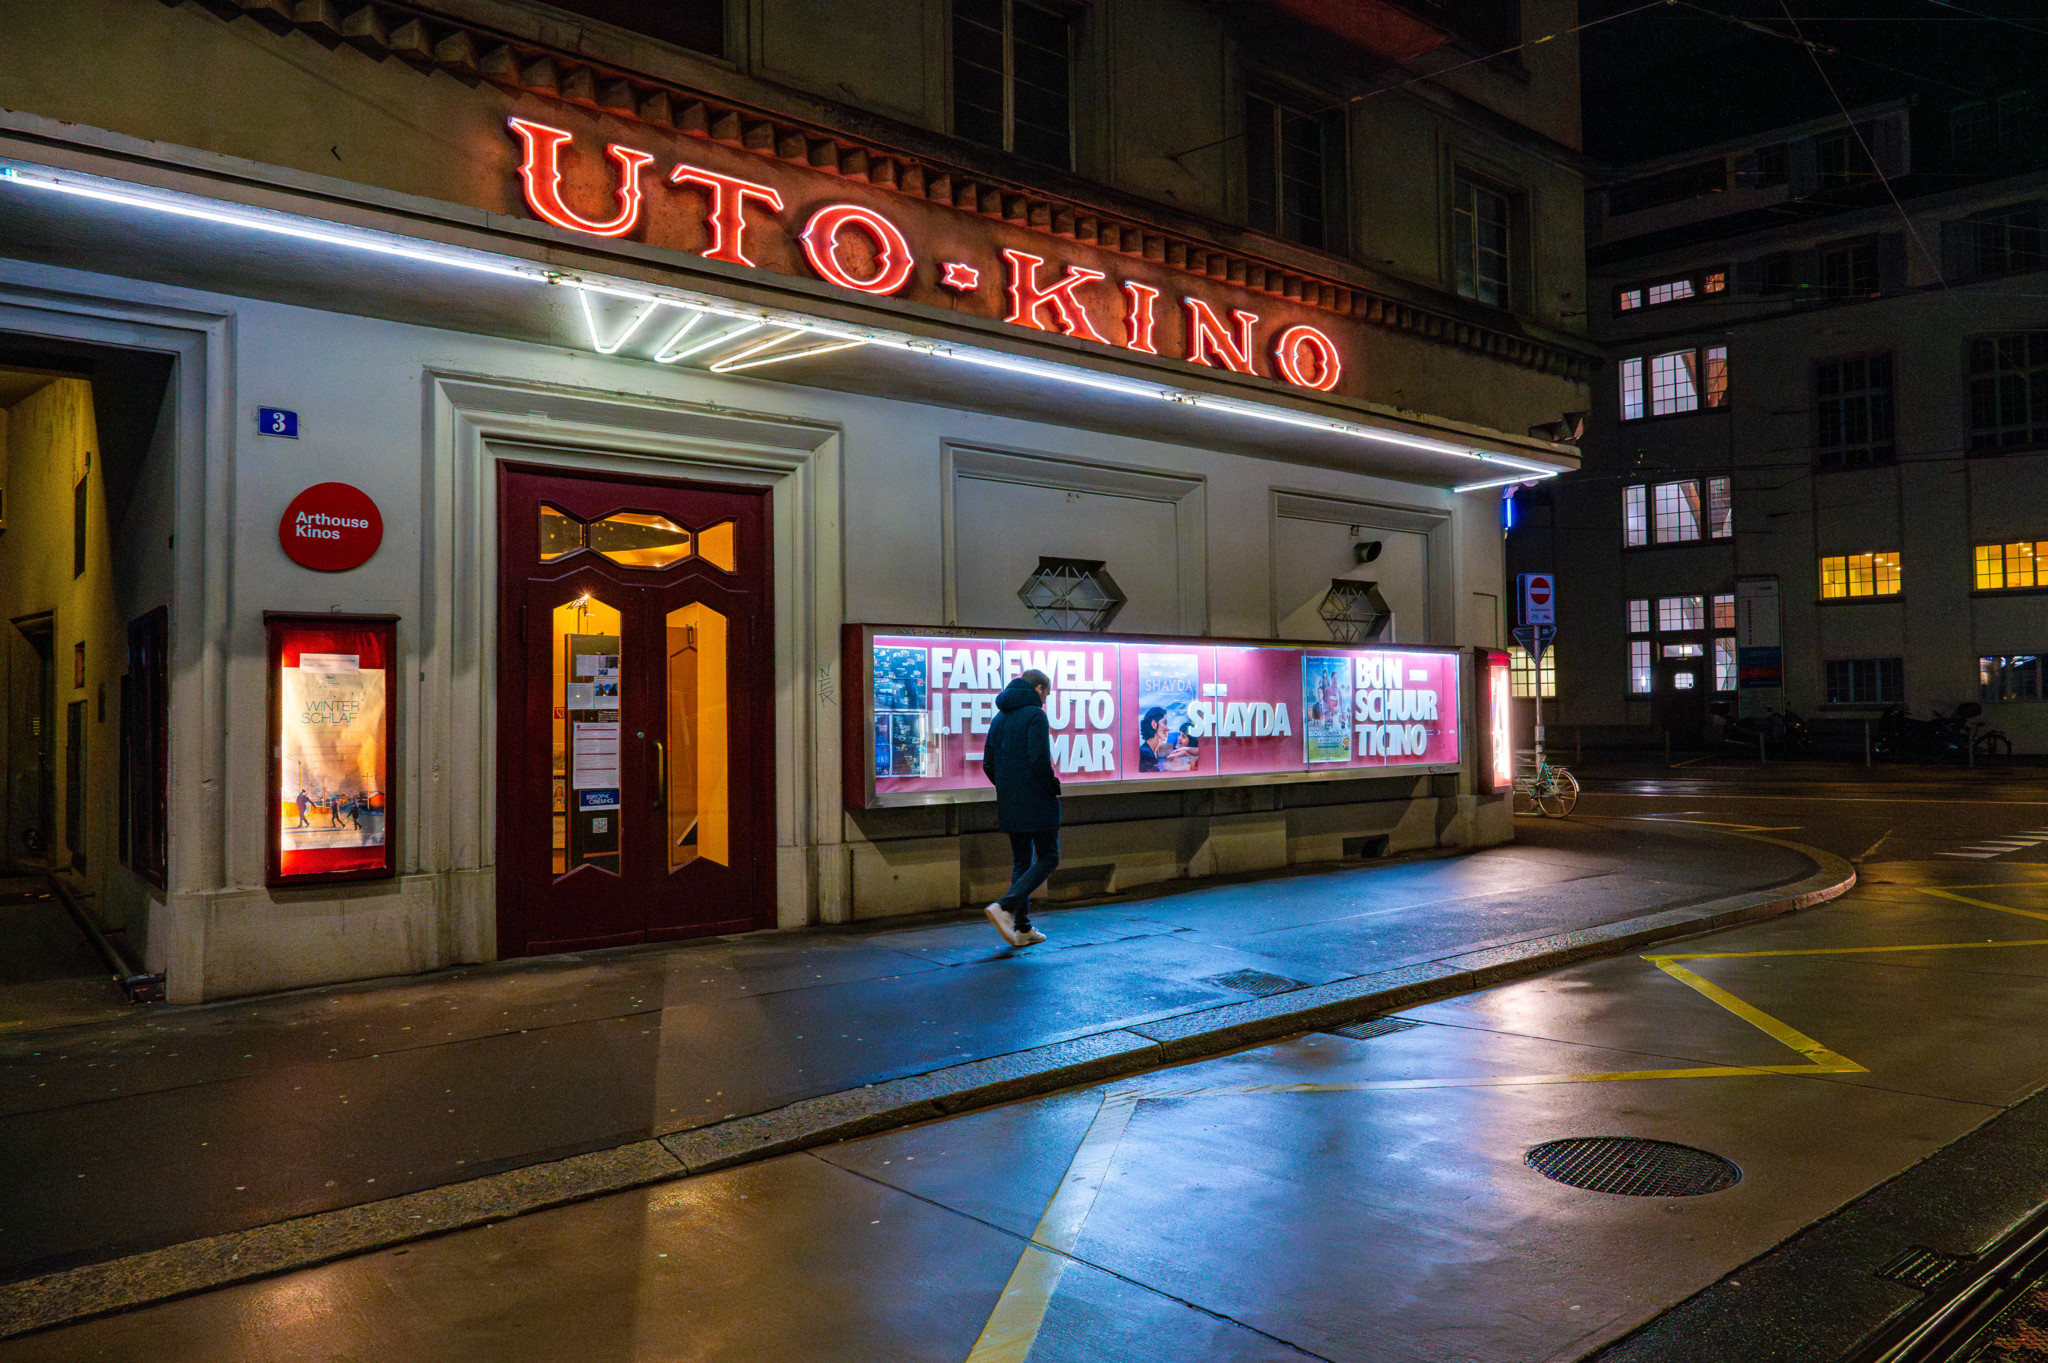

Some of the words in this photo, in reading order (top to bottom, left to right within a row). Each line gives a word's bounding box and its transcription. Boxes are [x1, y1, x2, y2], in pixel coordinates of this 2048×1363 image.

[508, 116, 915, 297] UTO
[1002, 247, 1342, 393] KINO
[272, 412, 286, 433] 3
[295, 511, 369, 529] Arthouse
[295, 525, 341, 540] Kinos
[931, 647, 1112, 691] FAREWELL
[1144, 679, 1193, 692] SHAYDA
[1354, 656, 1403, 690] BON
[301, 712, 358, 724] SCHLAF
[305, 700, 360, 712] WINTER
[1046, 691, 1115, 730] UTO
[1187, 700, 1293, 738] SHAYDA
[1354, 689, 1439, 722] SCHUUR
[1049, 733, 1115, 774] MAR
[1354, 723, 1428, 757] TICINO
